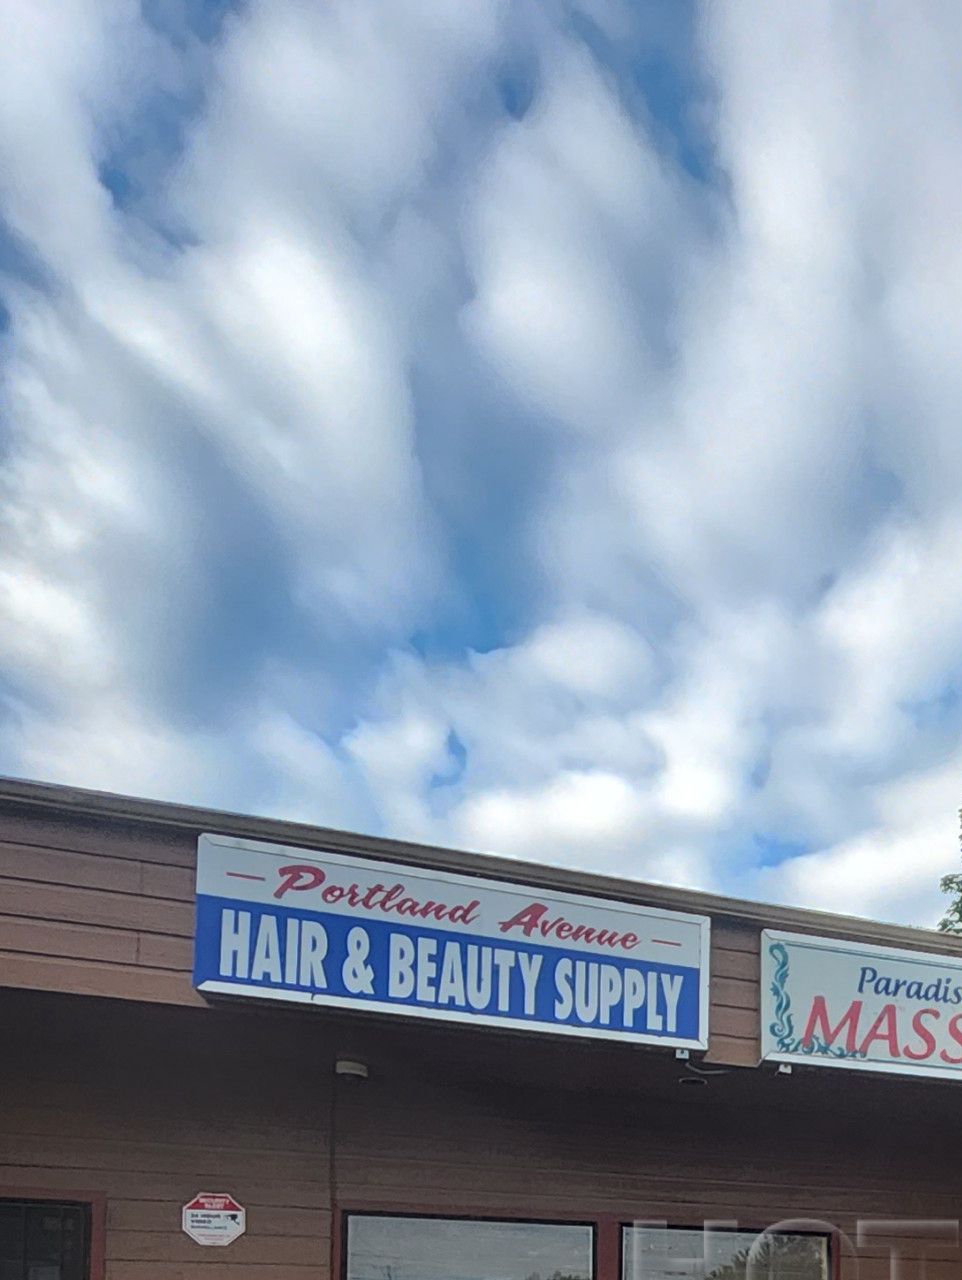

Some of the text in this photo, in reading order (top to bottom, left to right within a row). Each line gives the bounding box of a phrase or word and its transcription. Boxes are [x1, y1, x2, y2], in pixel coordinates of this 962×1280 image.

[273, 864, 643, 951] Portland Avenue
[219, 908, 684, 1033] HAIR & BEAUTY SUPPLY
